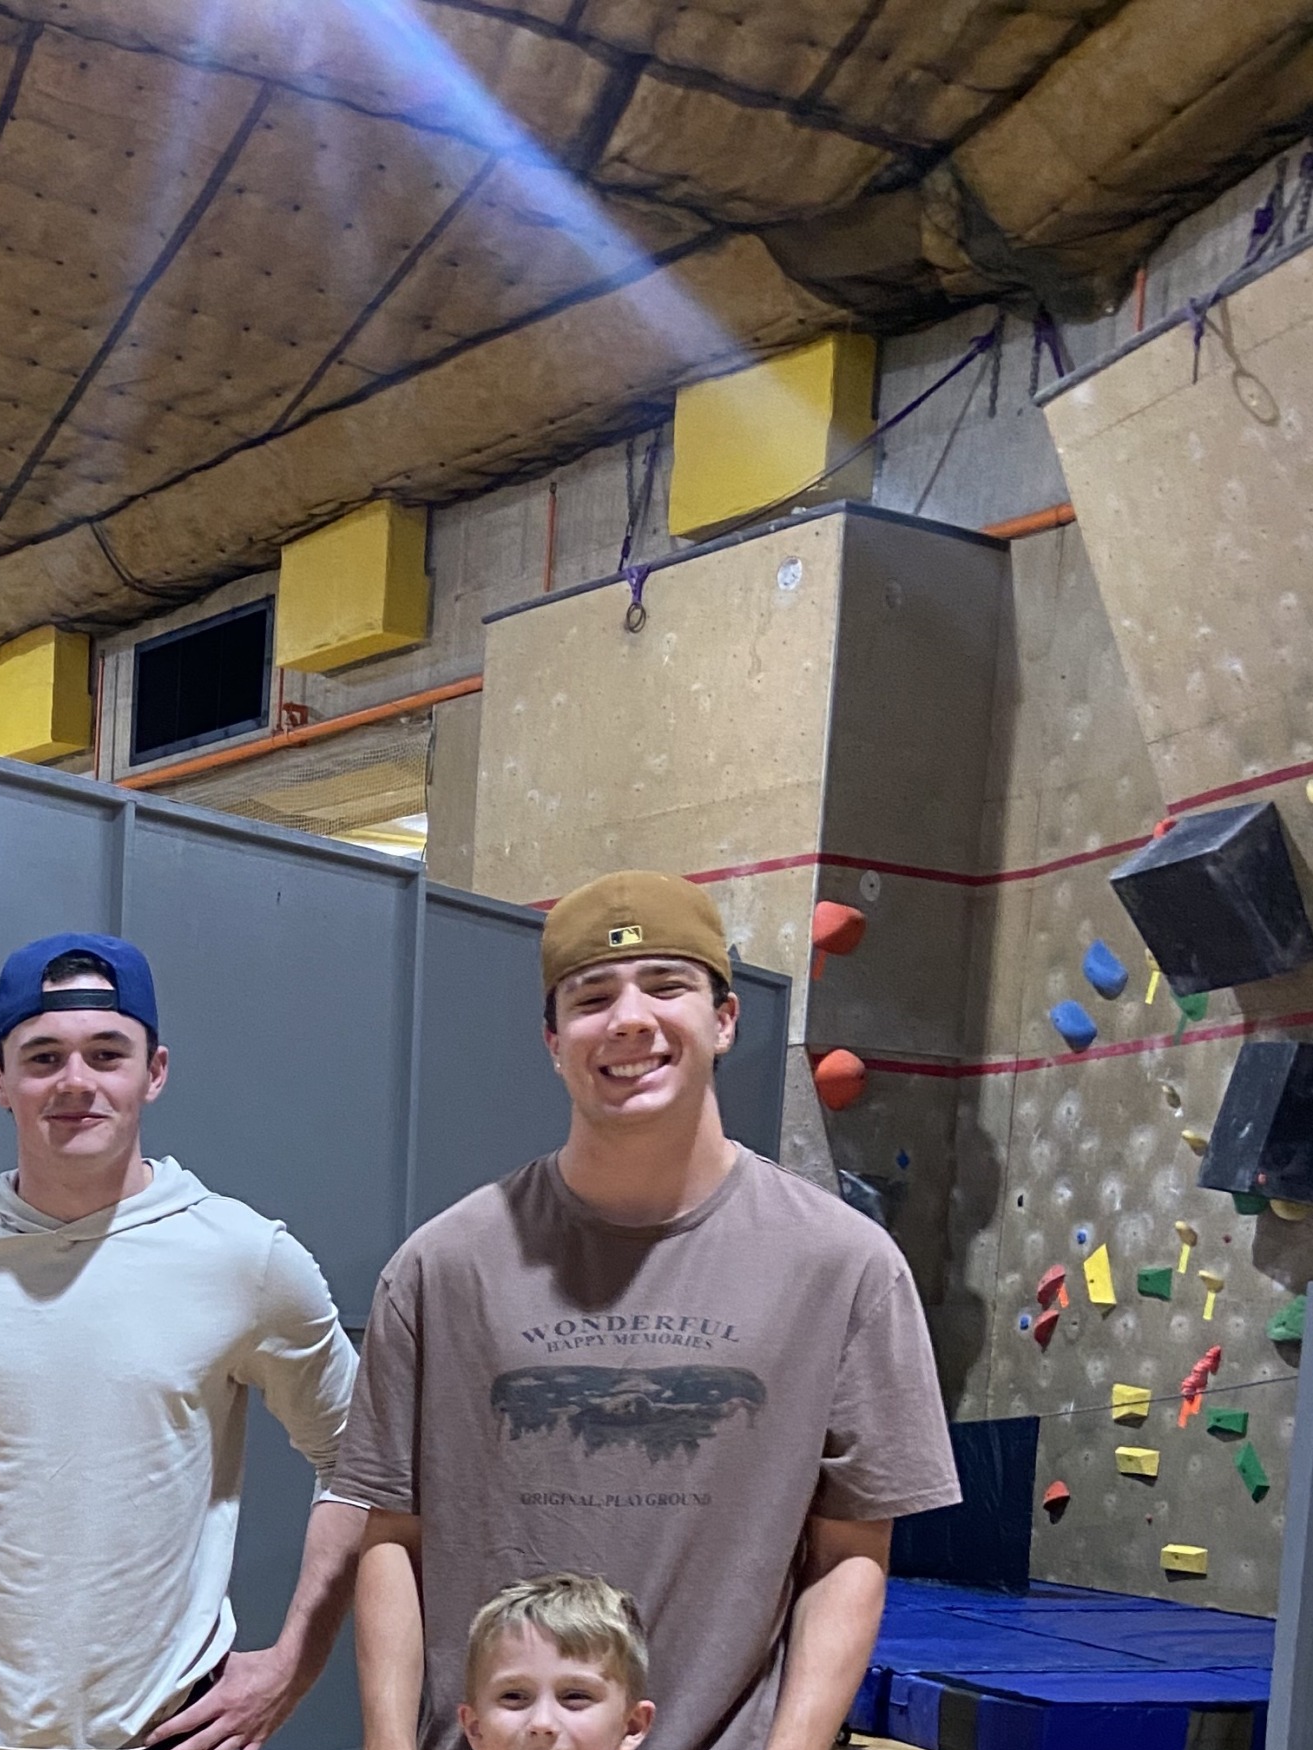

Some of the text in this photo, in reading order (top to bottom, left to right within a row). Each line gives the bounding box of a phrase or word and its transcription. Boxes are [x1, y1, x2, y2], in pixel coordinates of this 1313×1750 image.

[521, 1314, 741, 1344] WONDERFUL
[546, 1332, 714, 1354] HAPPY MEMORIES
[605, 1492, 713, 1508] PLAYGROUND
